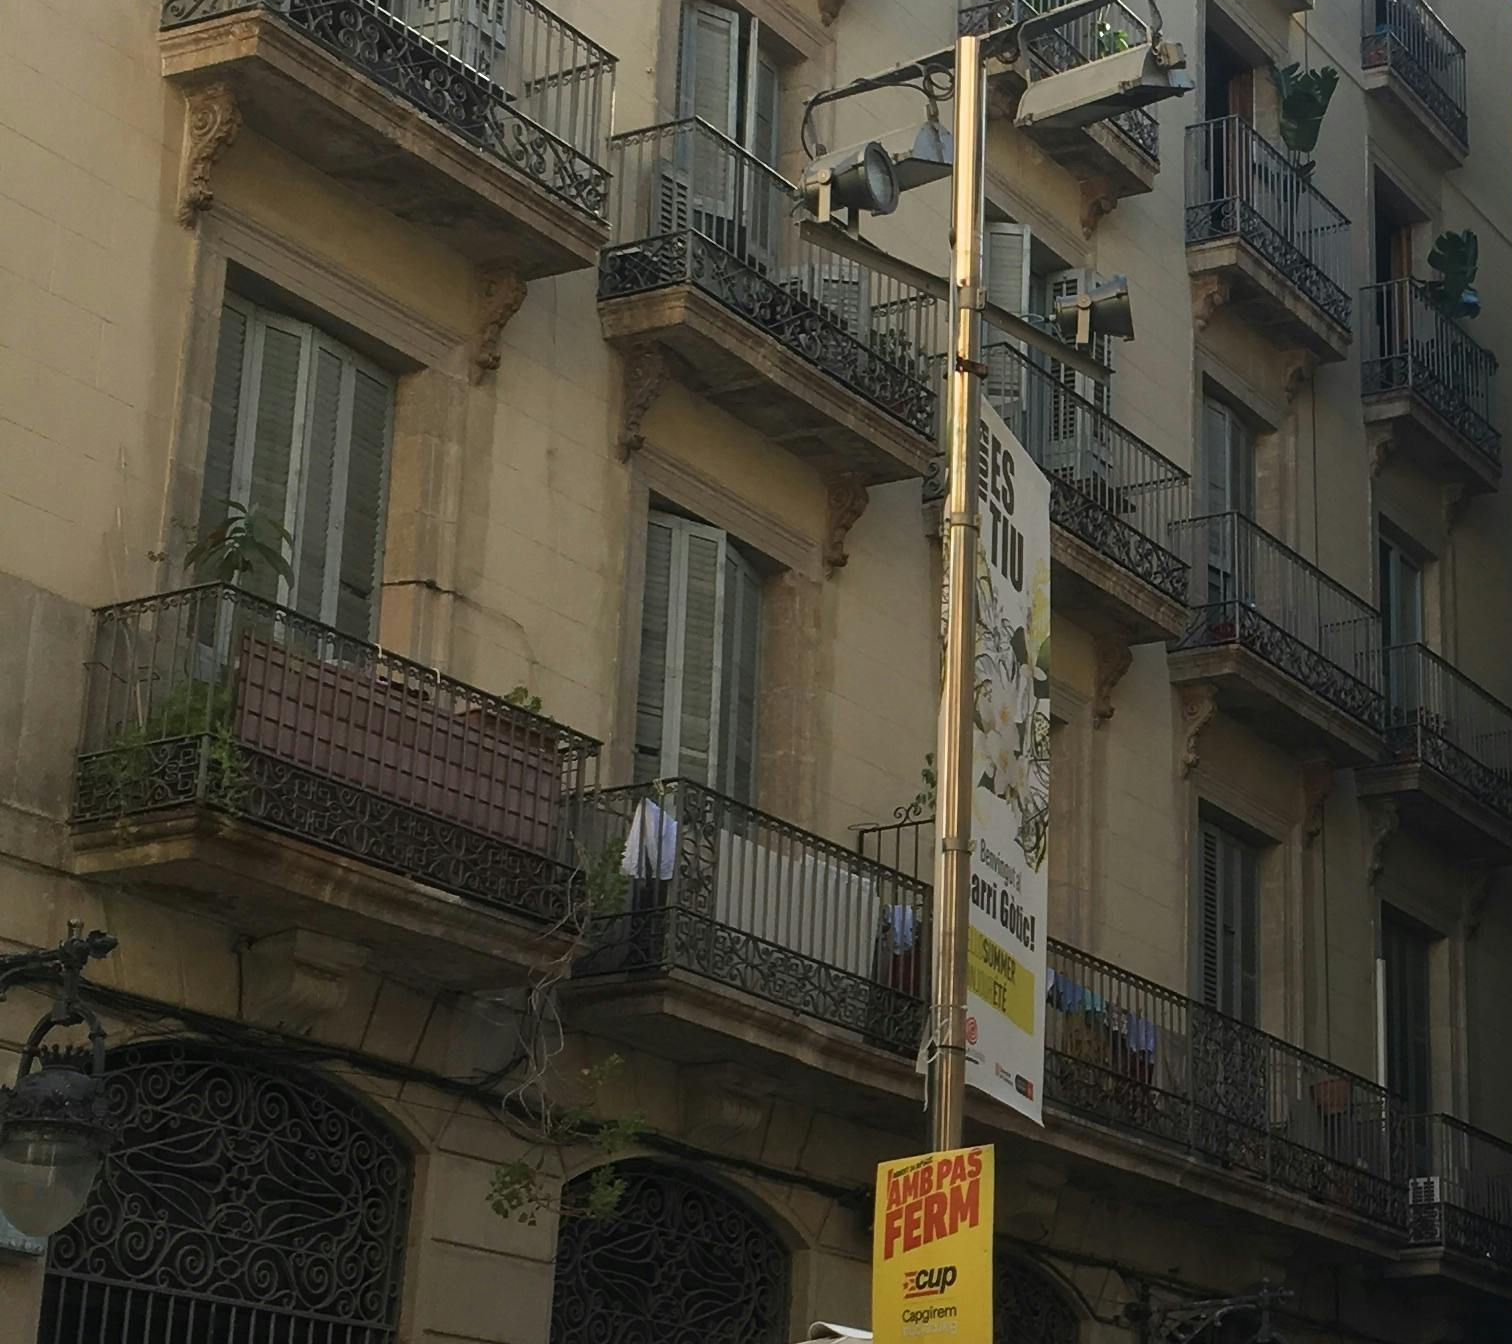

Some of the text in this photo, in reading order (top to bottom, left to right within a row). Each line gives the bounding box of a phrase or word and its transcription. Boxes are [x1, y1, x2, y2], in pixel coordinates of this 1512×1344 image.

[991, 433, 1015, 517] ES
[990, 498, 1024, 593] TIU
[971, 873, 998, 919] arri
[983, 938, 1016, 985] SUMMER
[886, 1165, 934, 1211] AMB
[936, 1149, 983, 1191] PAS
[884, 1177, 981, 1261] FERM
[915, 1265, 958, 1295] cup
[902, 1305, 957, 1325] Capgirem
